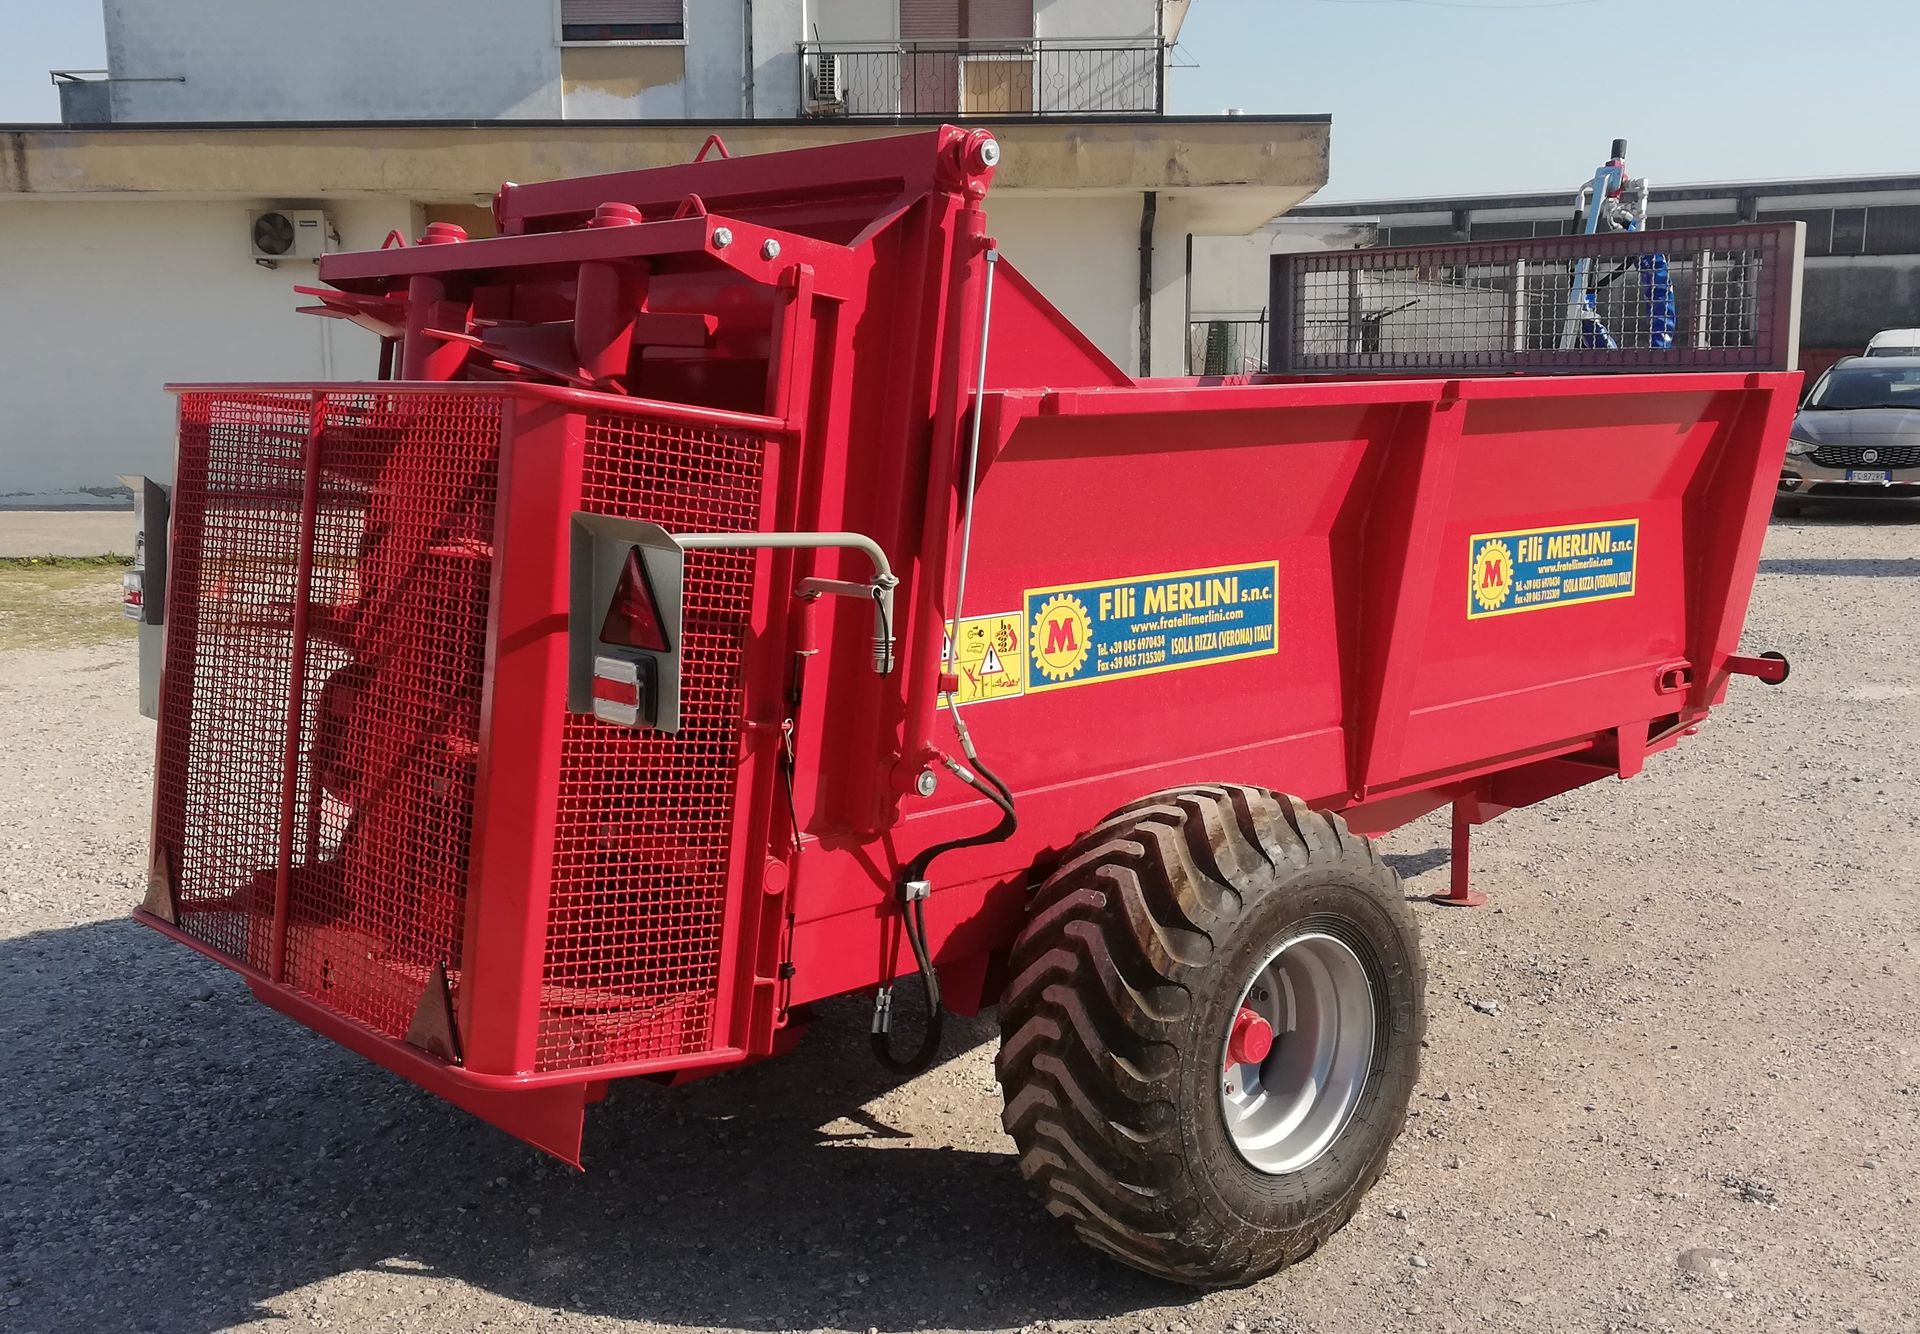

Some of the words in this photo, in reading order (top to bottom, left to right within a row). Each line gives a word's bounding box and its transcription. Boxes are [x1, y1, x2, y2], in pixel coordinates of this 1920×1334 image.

[1518, 536, 1543, 563] F.lli
[1547, 531, 1611, 559] MERLINI
[1612, 540, 1633, 552] s.n.c.
[1482, 559, 1503, 588] M
[1538, 556, 1613, 574] www.fratellimerlini.com
[1563, 578, 1578, 593] ISOLA
[1579, 576, 1594, 591] RIZZA
[1595, 573, 1618, 591] (VERONA)
[1619, 571, 1631, 586] ITALY
[1099, 587, 1135, 621] F.lli
[1143, 576, 1239, 615] MERLINI
[1241, 586, 1272, 602] s.n.c.
[1131, 609, 1244, 633] www.fratellimerlini.com
[1045, 617, 1077, 655] M
[1097, 642, 1109, 656] Tel.
[1109, 641, 1122, 654] +39
[1123, 639, 1136, 652] 045
[1137, 634, 1165, 650] 6970434
[1171, 636, 1193, 655] ISOLA
[1195, 632, 1217, 651] RIZZA
[1218, 626, 1253, 650] (VERONA)
[1254, 624, 1273, 643] ITALY
[1097, 659, 1109, 672] Fax
[1110, 656, 1123, 669] +39
[1124, 654, 1136, 667] 045
[1138, 650, 1166, 666] 7135309
